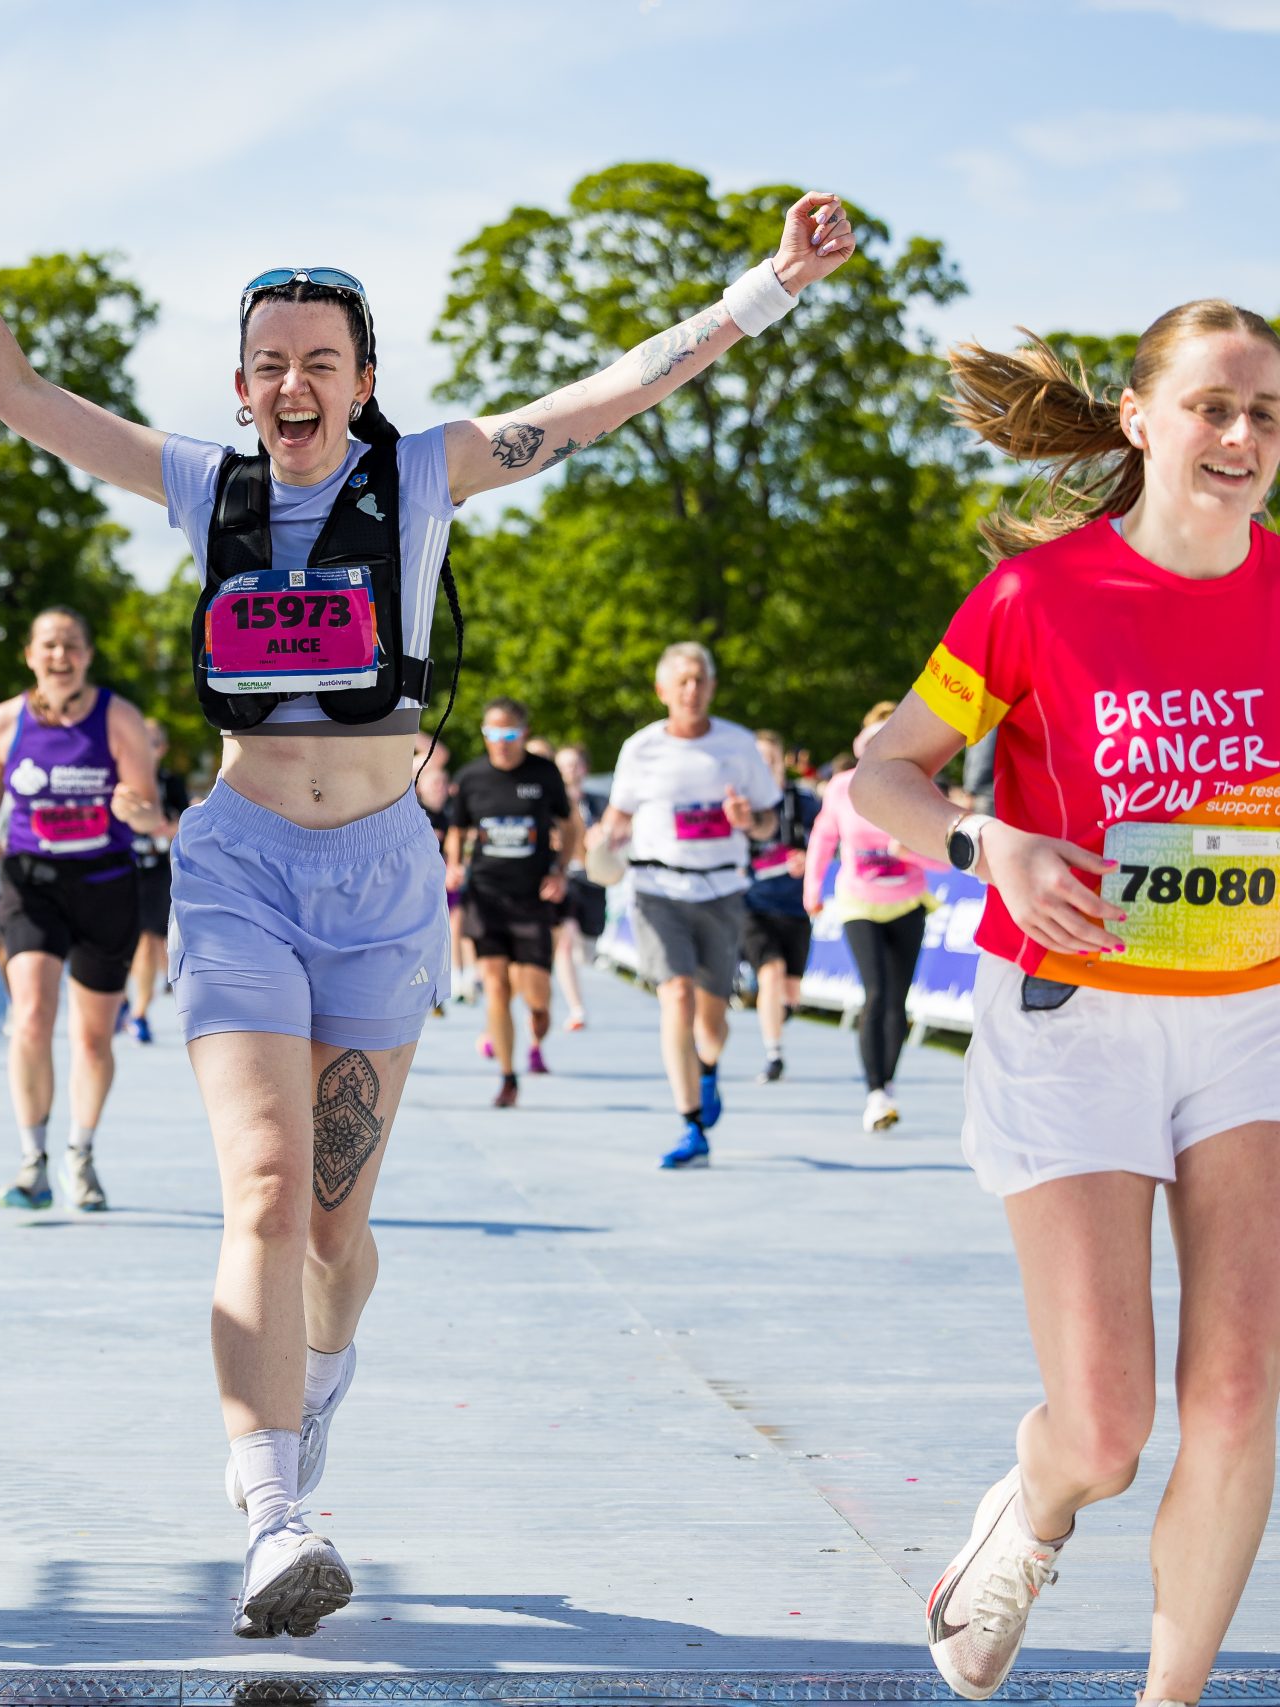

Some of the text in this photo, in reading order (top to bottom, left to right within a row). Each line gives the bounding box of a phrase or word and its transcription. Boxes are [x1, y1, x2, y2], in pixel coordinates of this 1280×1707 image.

[231, 595, 352, 630] 15973
[267, 637, 321, 655] ALICE
[940, 673, 975, 702] NOW
[1093, 688, 1265, 736] BREAST
[1093, 733, 1280, 778] CANCER
[1101, 779, 1202, 820] NOW
[1213, 781, 1245, 797] The
[1206, 800, 1270, 816] support
[1125, 847, 1192, 865] EMPATHY
[1119, 864, 1276, 908] 78080
[1126, 923, 1174, 938] WORTH
